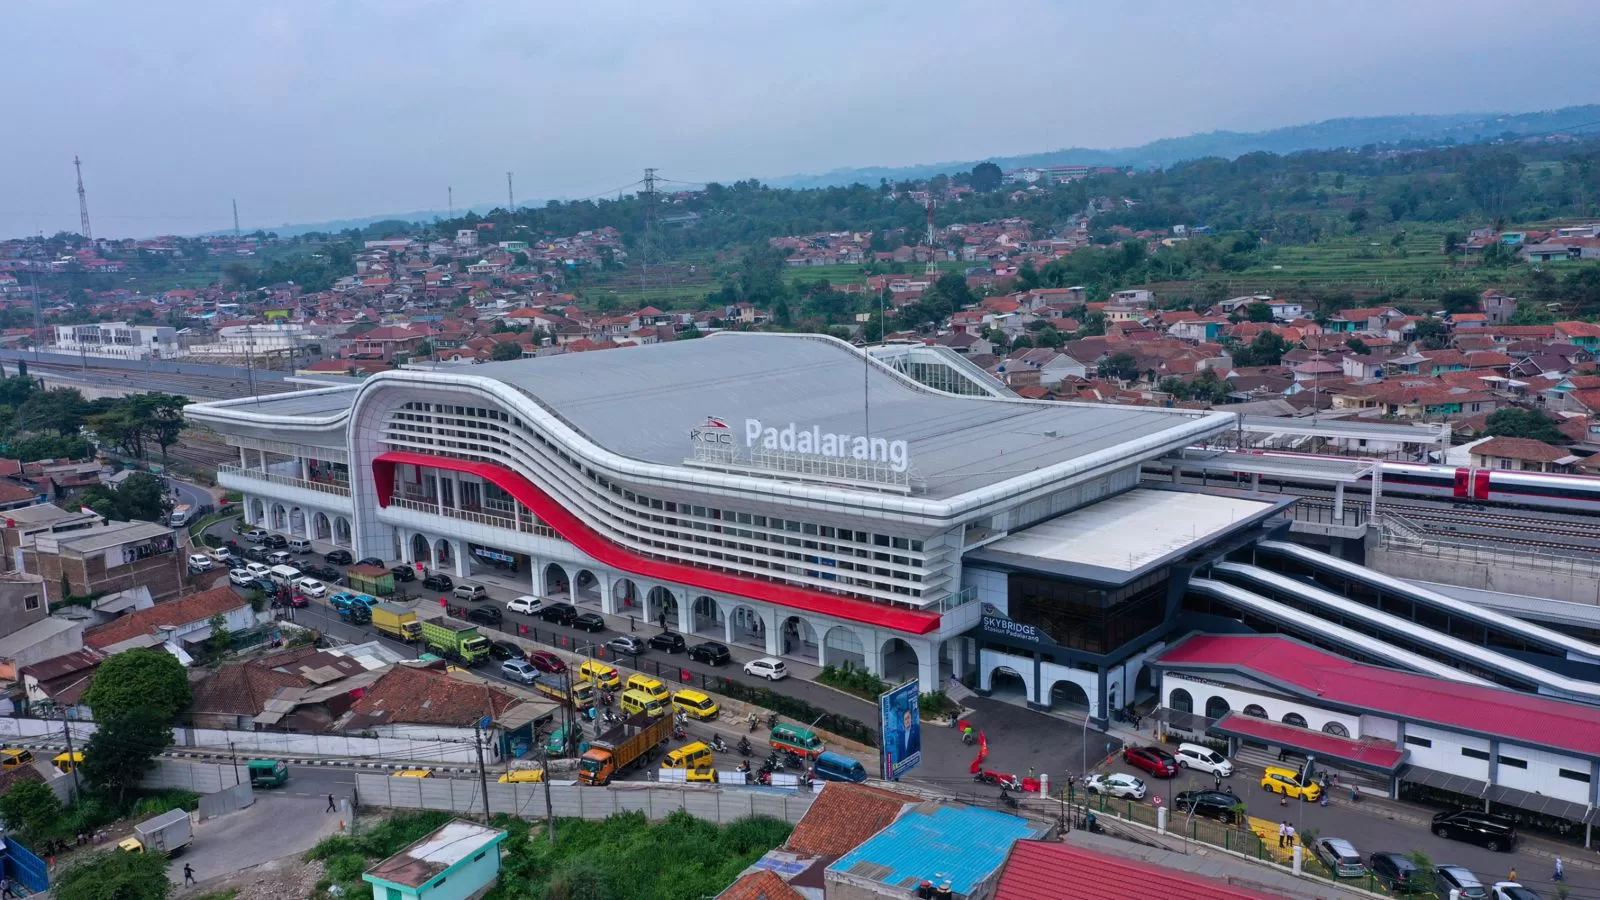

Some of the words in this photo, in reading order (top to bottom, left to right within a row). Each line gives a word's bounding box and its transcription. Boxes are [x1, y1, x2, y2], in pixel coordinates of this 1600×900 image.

[690, 428, 731, 445] KCIC
[745, 418, 908, 472] Padalarang
[983, 617, 1035, 635] SKYBRIDGE
